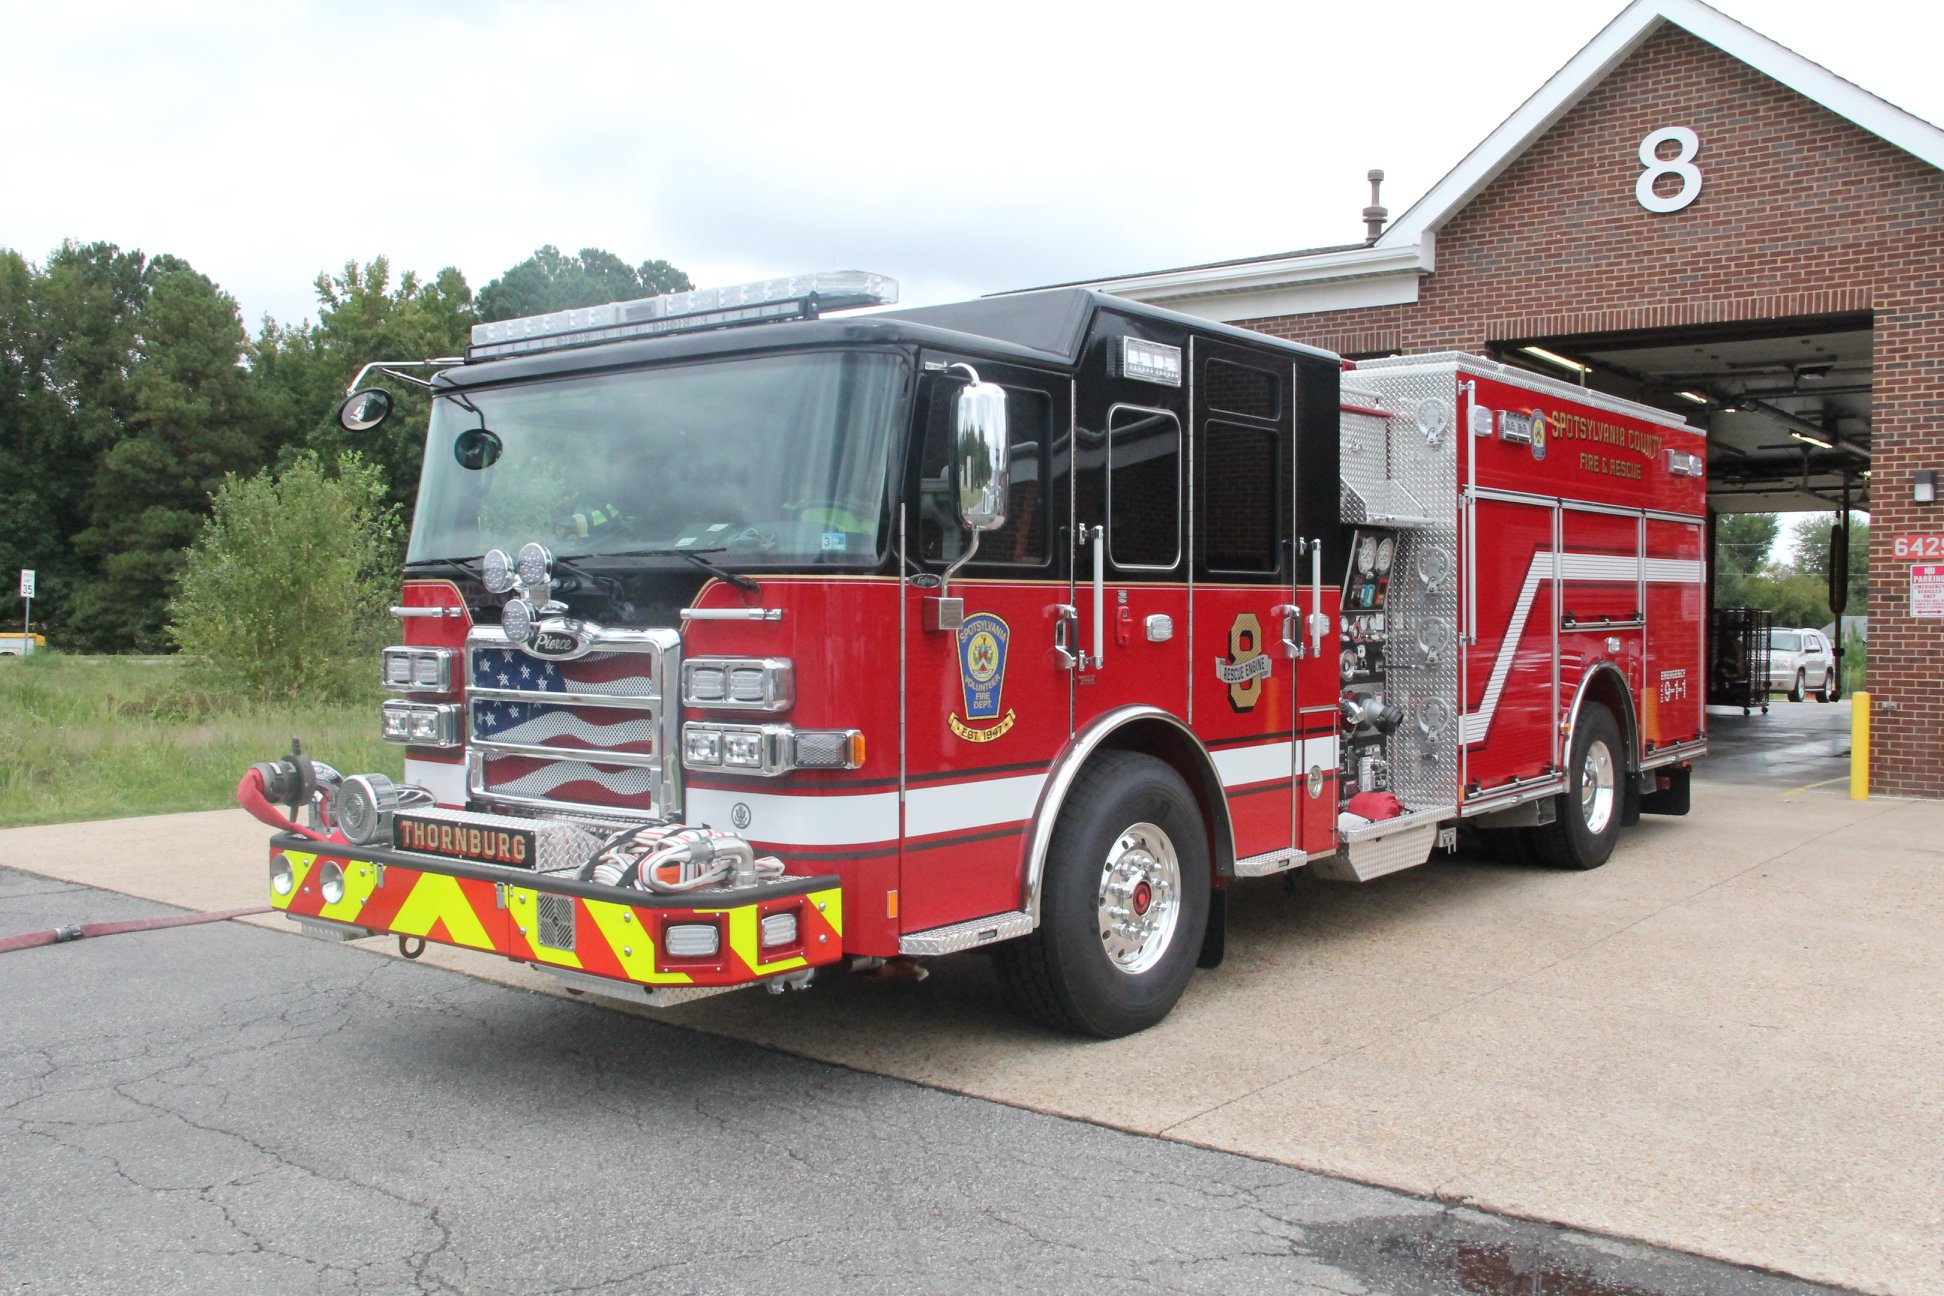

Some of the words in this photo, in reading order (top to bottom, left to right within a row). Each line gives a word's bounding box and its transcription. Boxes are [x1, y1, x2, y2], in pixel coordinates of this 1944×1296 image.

[1636, 126, 1702, 213] 8
[1552, 411, 1625, 447] SPOTSYLVANIA
[1628, 430, 1662, 459] COUNTY
[1580, 453, 1599, 472] FIRE
[1602, 457, 1608, 474] &
[1610, 459, 1642, 480] RESCUE
[1895, 538, 1944, 556] 642
[1924, 567, 1936, 575] NO
[959, 621, 1006, 642] SPOTSYLVANIA
[534, 633, 572, 652] Pierce
[1224, 666, 1244, 681] RESCUE
[1245, 657, 1265, 677] ENGINE
[1228, 612, 1262, 713] 8
[965, 675, 1001, 691] VOLUNTEER
[975, 691, 991, 700] FIRE
[983, 725, 1003, 740] 1947
[400, 820, 526, 864] THORNBURG
